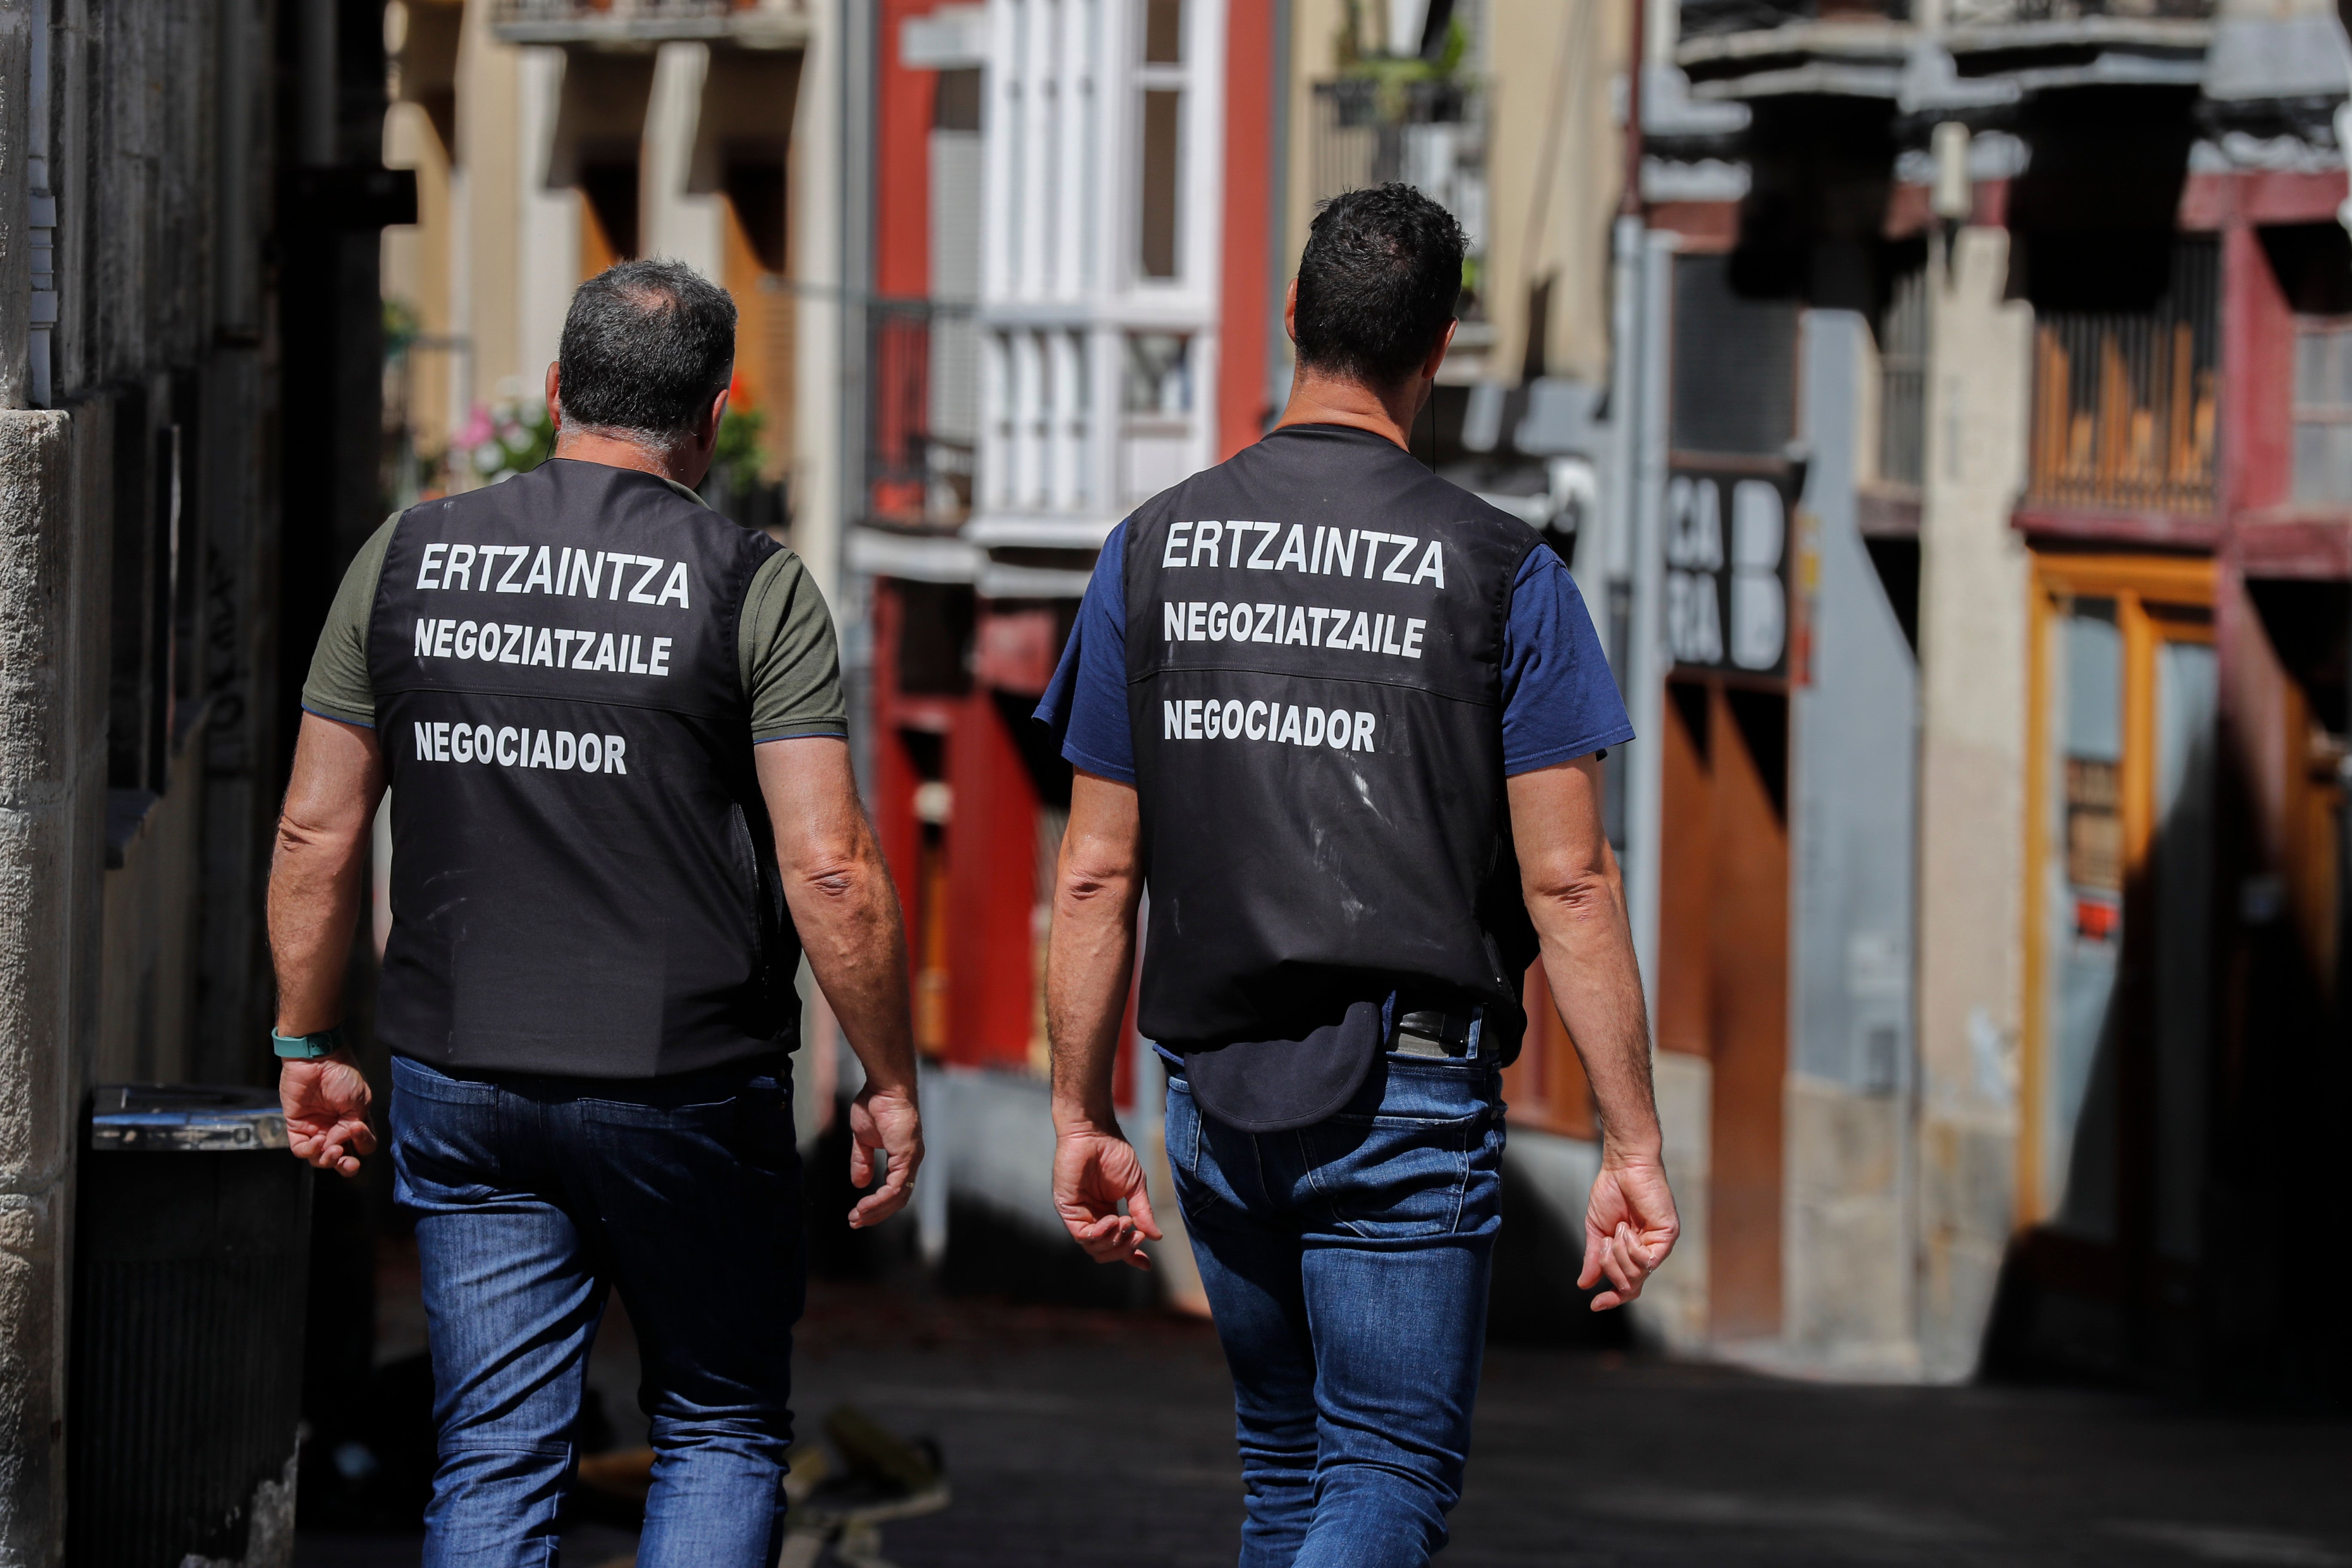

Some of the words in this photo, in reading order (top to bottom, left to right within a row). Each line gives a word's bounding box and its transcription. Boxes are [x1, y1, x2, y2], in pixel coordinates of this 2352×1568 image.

[415, 543, 689, 609] ERTZAINTZA
[1162, 521, 1445, 590] ERTZAINTZA
[413, 618, 672, 677] NEGOZIATZAILE
[1164, 602, 1427, 659] NEGOZIATZAILE
[413, 722, 627, 775] NEGOCIADOR
[1163, 699, 1376, 753] NEGOCIADOR
